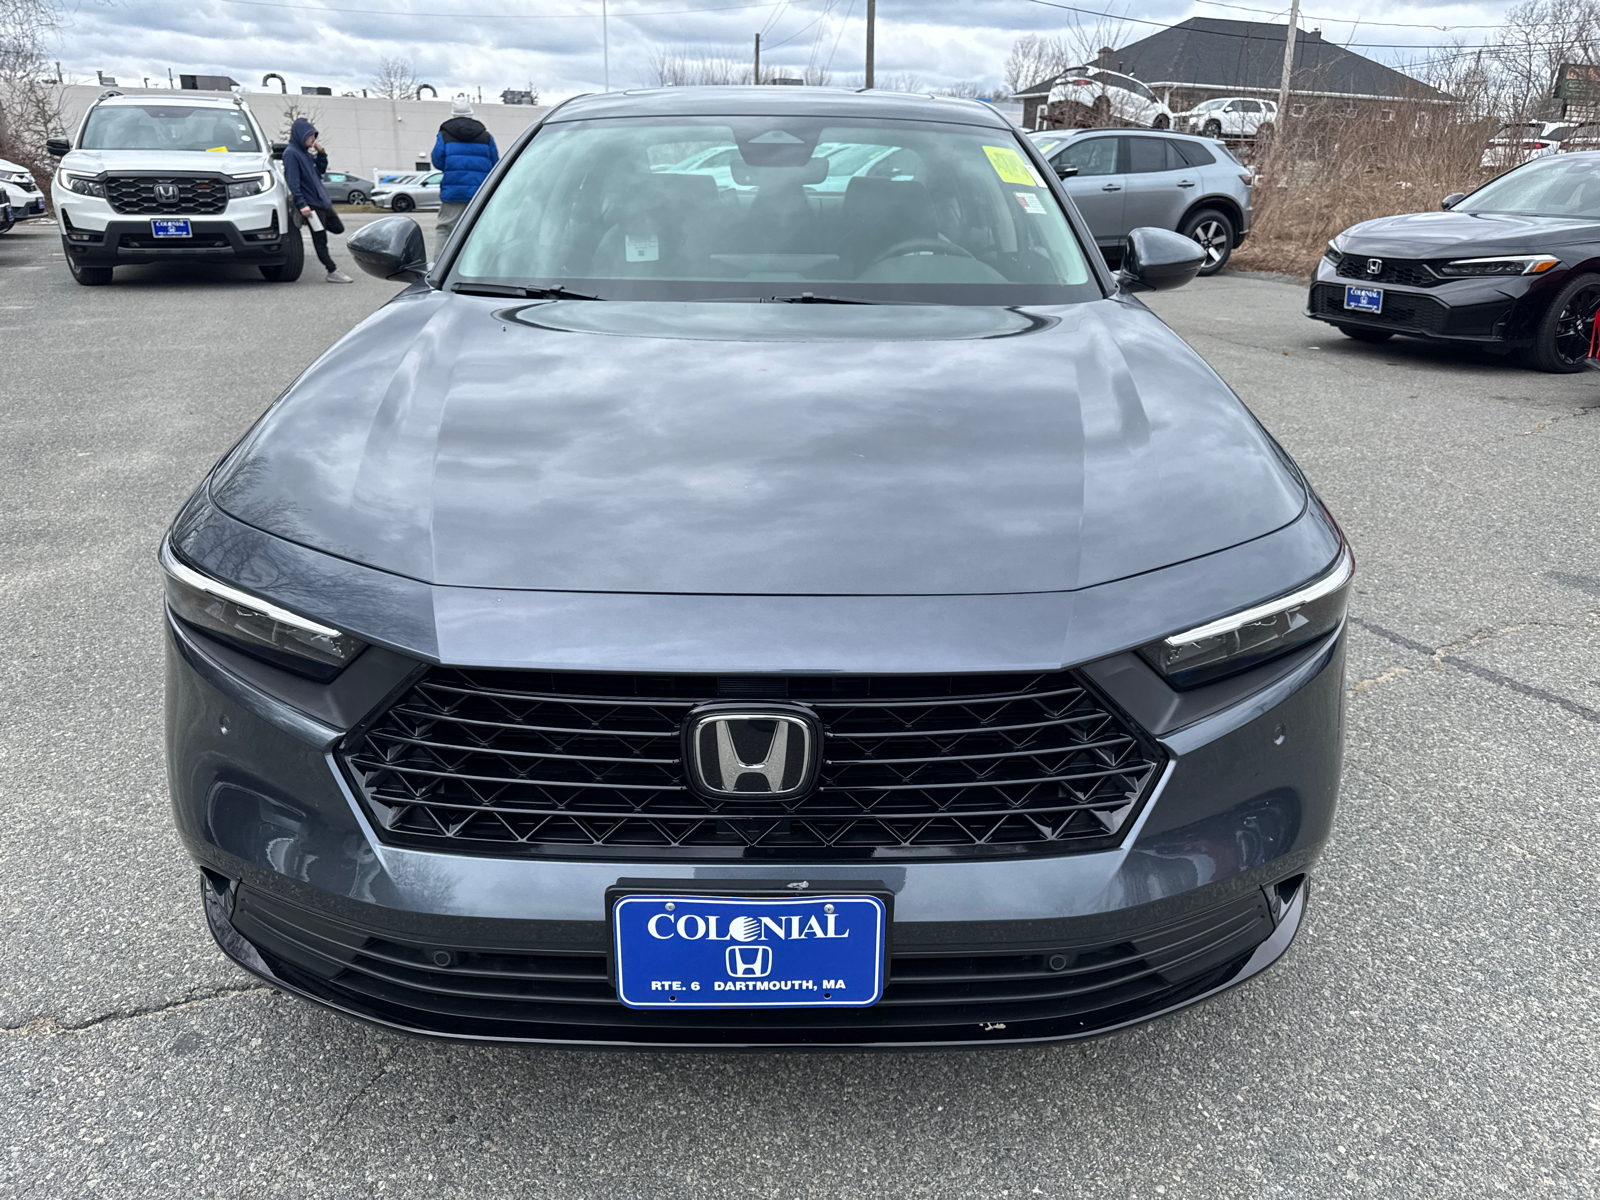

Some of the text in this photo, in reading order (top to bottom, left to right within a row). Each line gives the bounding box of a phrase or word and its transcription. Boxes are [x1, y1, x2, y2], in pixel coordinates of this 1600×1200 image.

[647, 913, 850, 942] COLONIAL
[651, 979, 846, 991] RTE. 6 DARTMOUTH, MA
